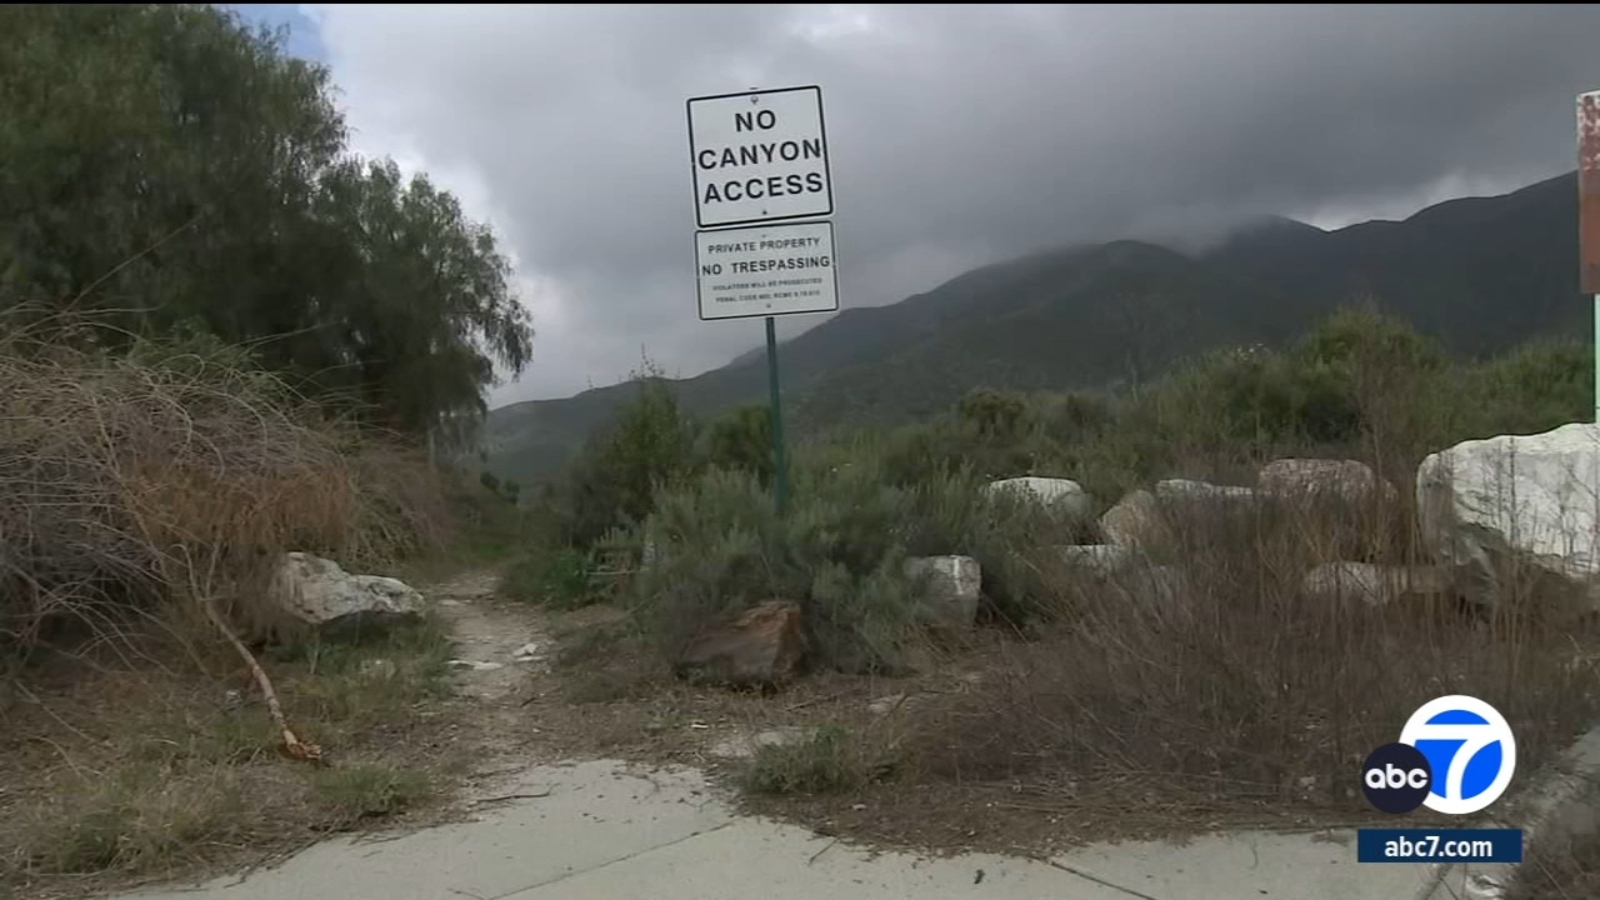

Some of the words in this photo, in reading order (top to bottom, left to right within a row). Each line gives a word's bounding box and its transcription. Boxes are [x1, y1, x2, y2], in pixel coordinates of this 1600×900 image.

[735, 109, 776, 132] NO
[698, 138, 821, 170] CANYON
[704, 172, 823, 204] ACCESS
[708, 242, 757, 254] PRIVATE
[760, 238, 820, 250] PROPERTY
[702, 263, 722, 276] NO
[730, 256, 830, 274] TRESPASSING
